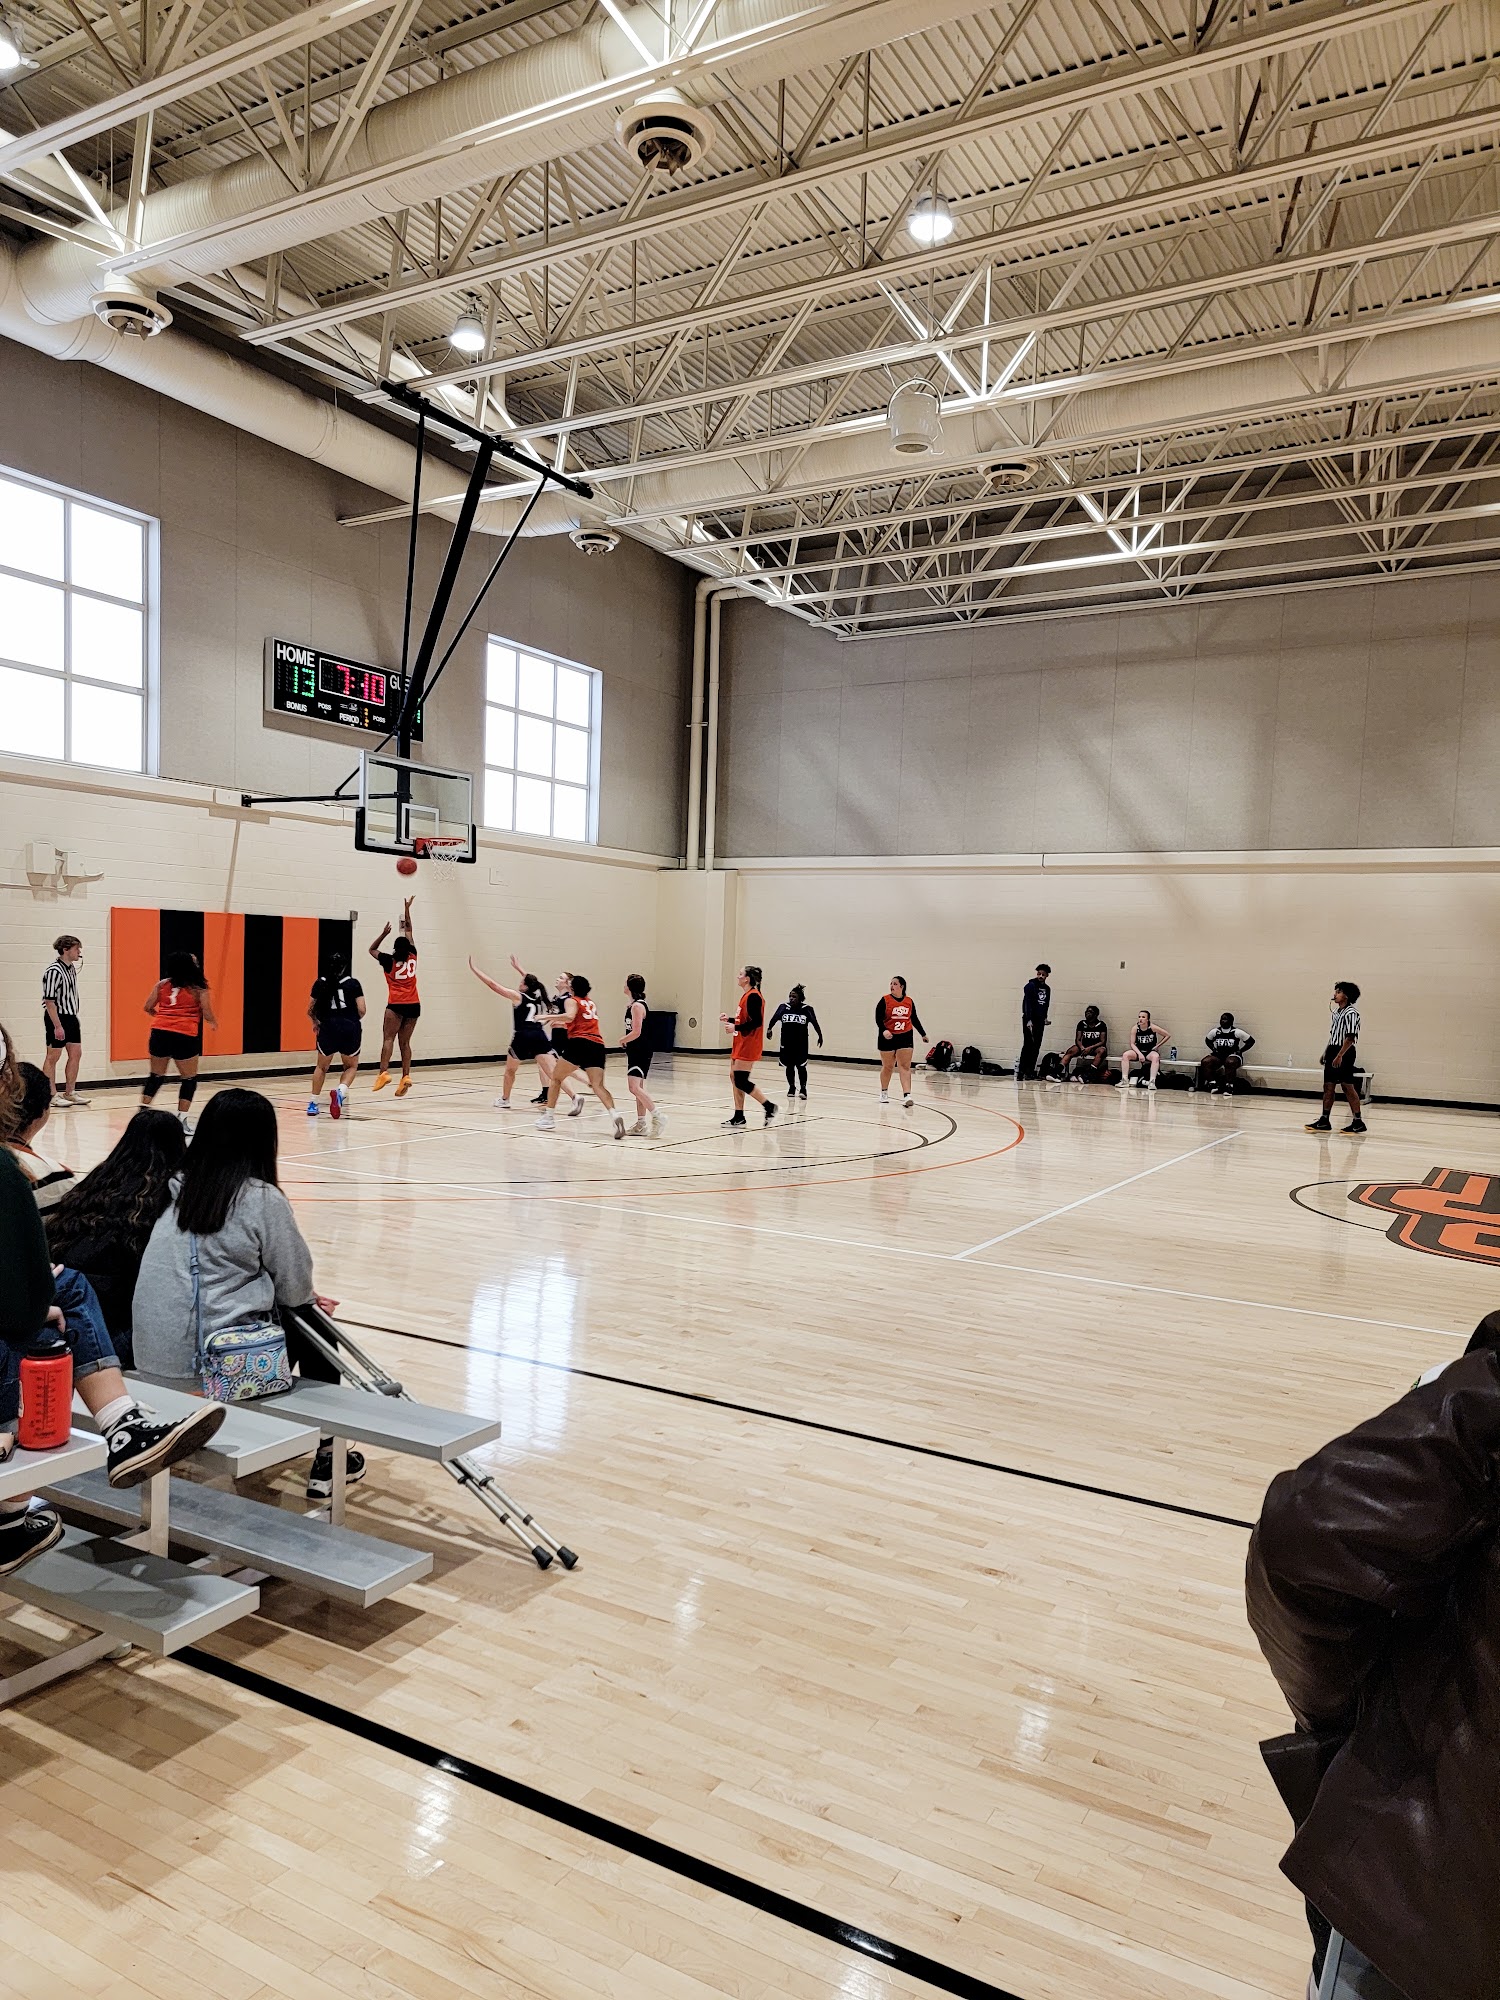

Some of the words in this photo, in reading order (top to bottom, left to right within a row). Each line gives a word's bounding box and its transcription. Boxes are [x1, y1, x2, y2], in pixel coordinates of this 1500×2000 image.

[276, 643, 316, 668] HOME
[292, 665, 315, 698] 13
[336, 664, 384, 704] 7:10
[286, 700, 308, 713] BONUS
[317, 701, 332, 711] POSS
[339, 712, 360, 724] PERIOD
[372, 714, 386, 724] POSS
[394, 959, 417, 980] 20
